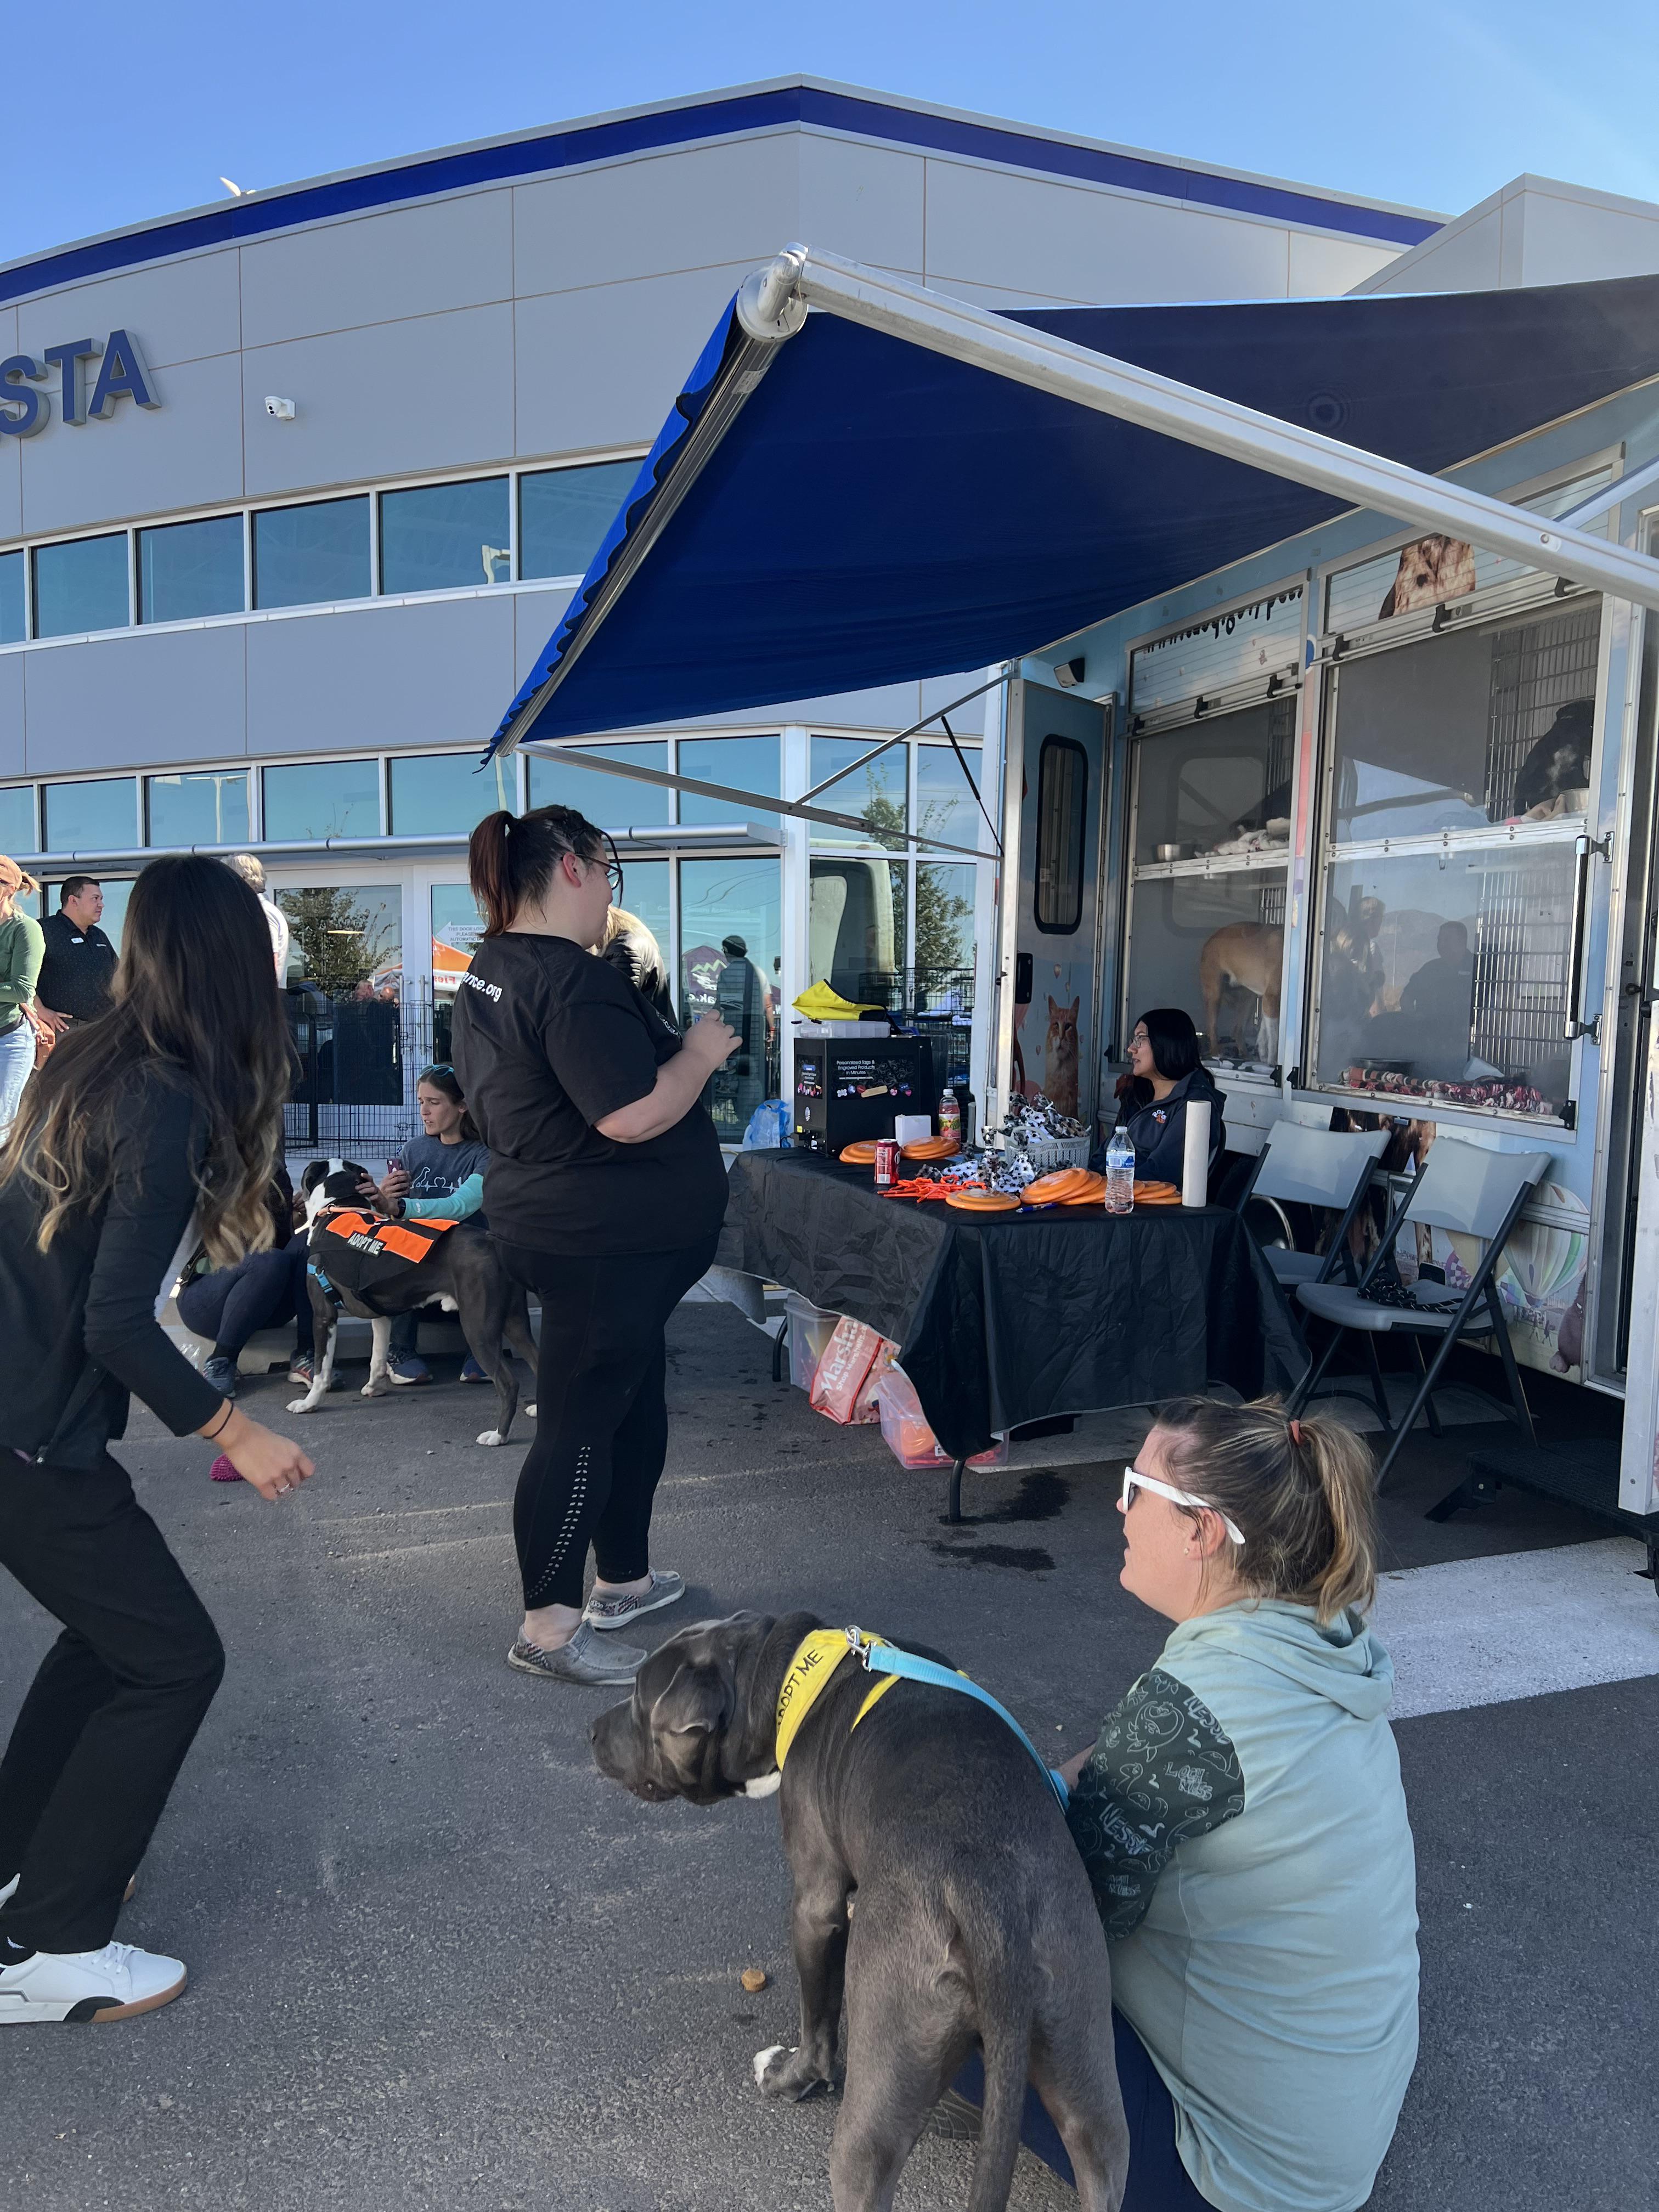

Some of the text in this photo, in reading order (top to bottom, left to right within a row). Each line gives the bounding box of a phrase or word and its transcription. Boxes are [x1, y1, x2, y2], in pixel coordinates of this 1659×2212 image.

[347, 1232, 383, 1255] ADOPT ME
[836, 1372, 850, 1391] Shop
[778, 1649, 823, 1726] DOPT ME
